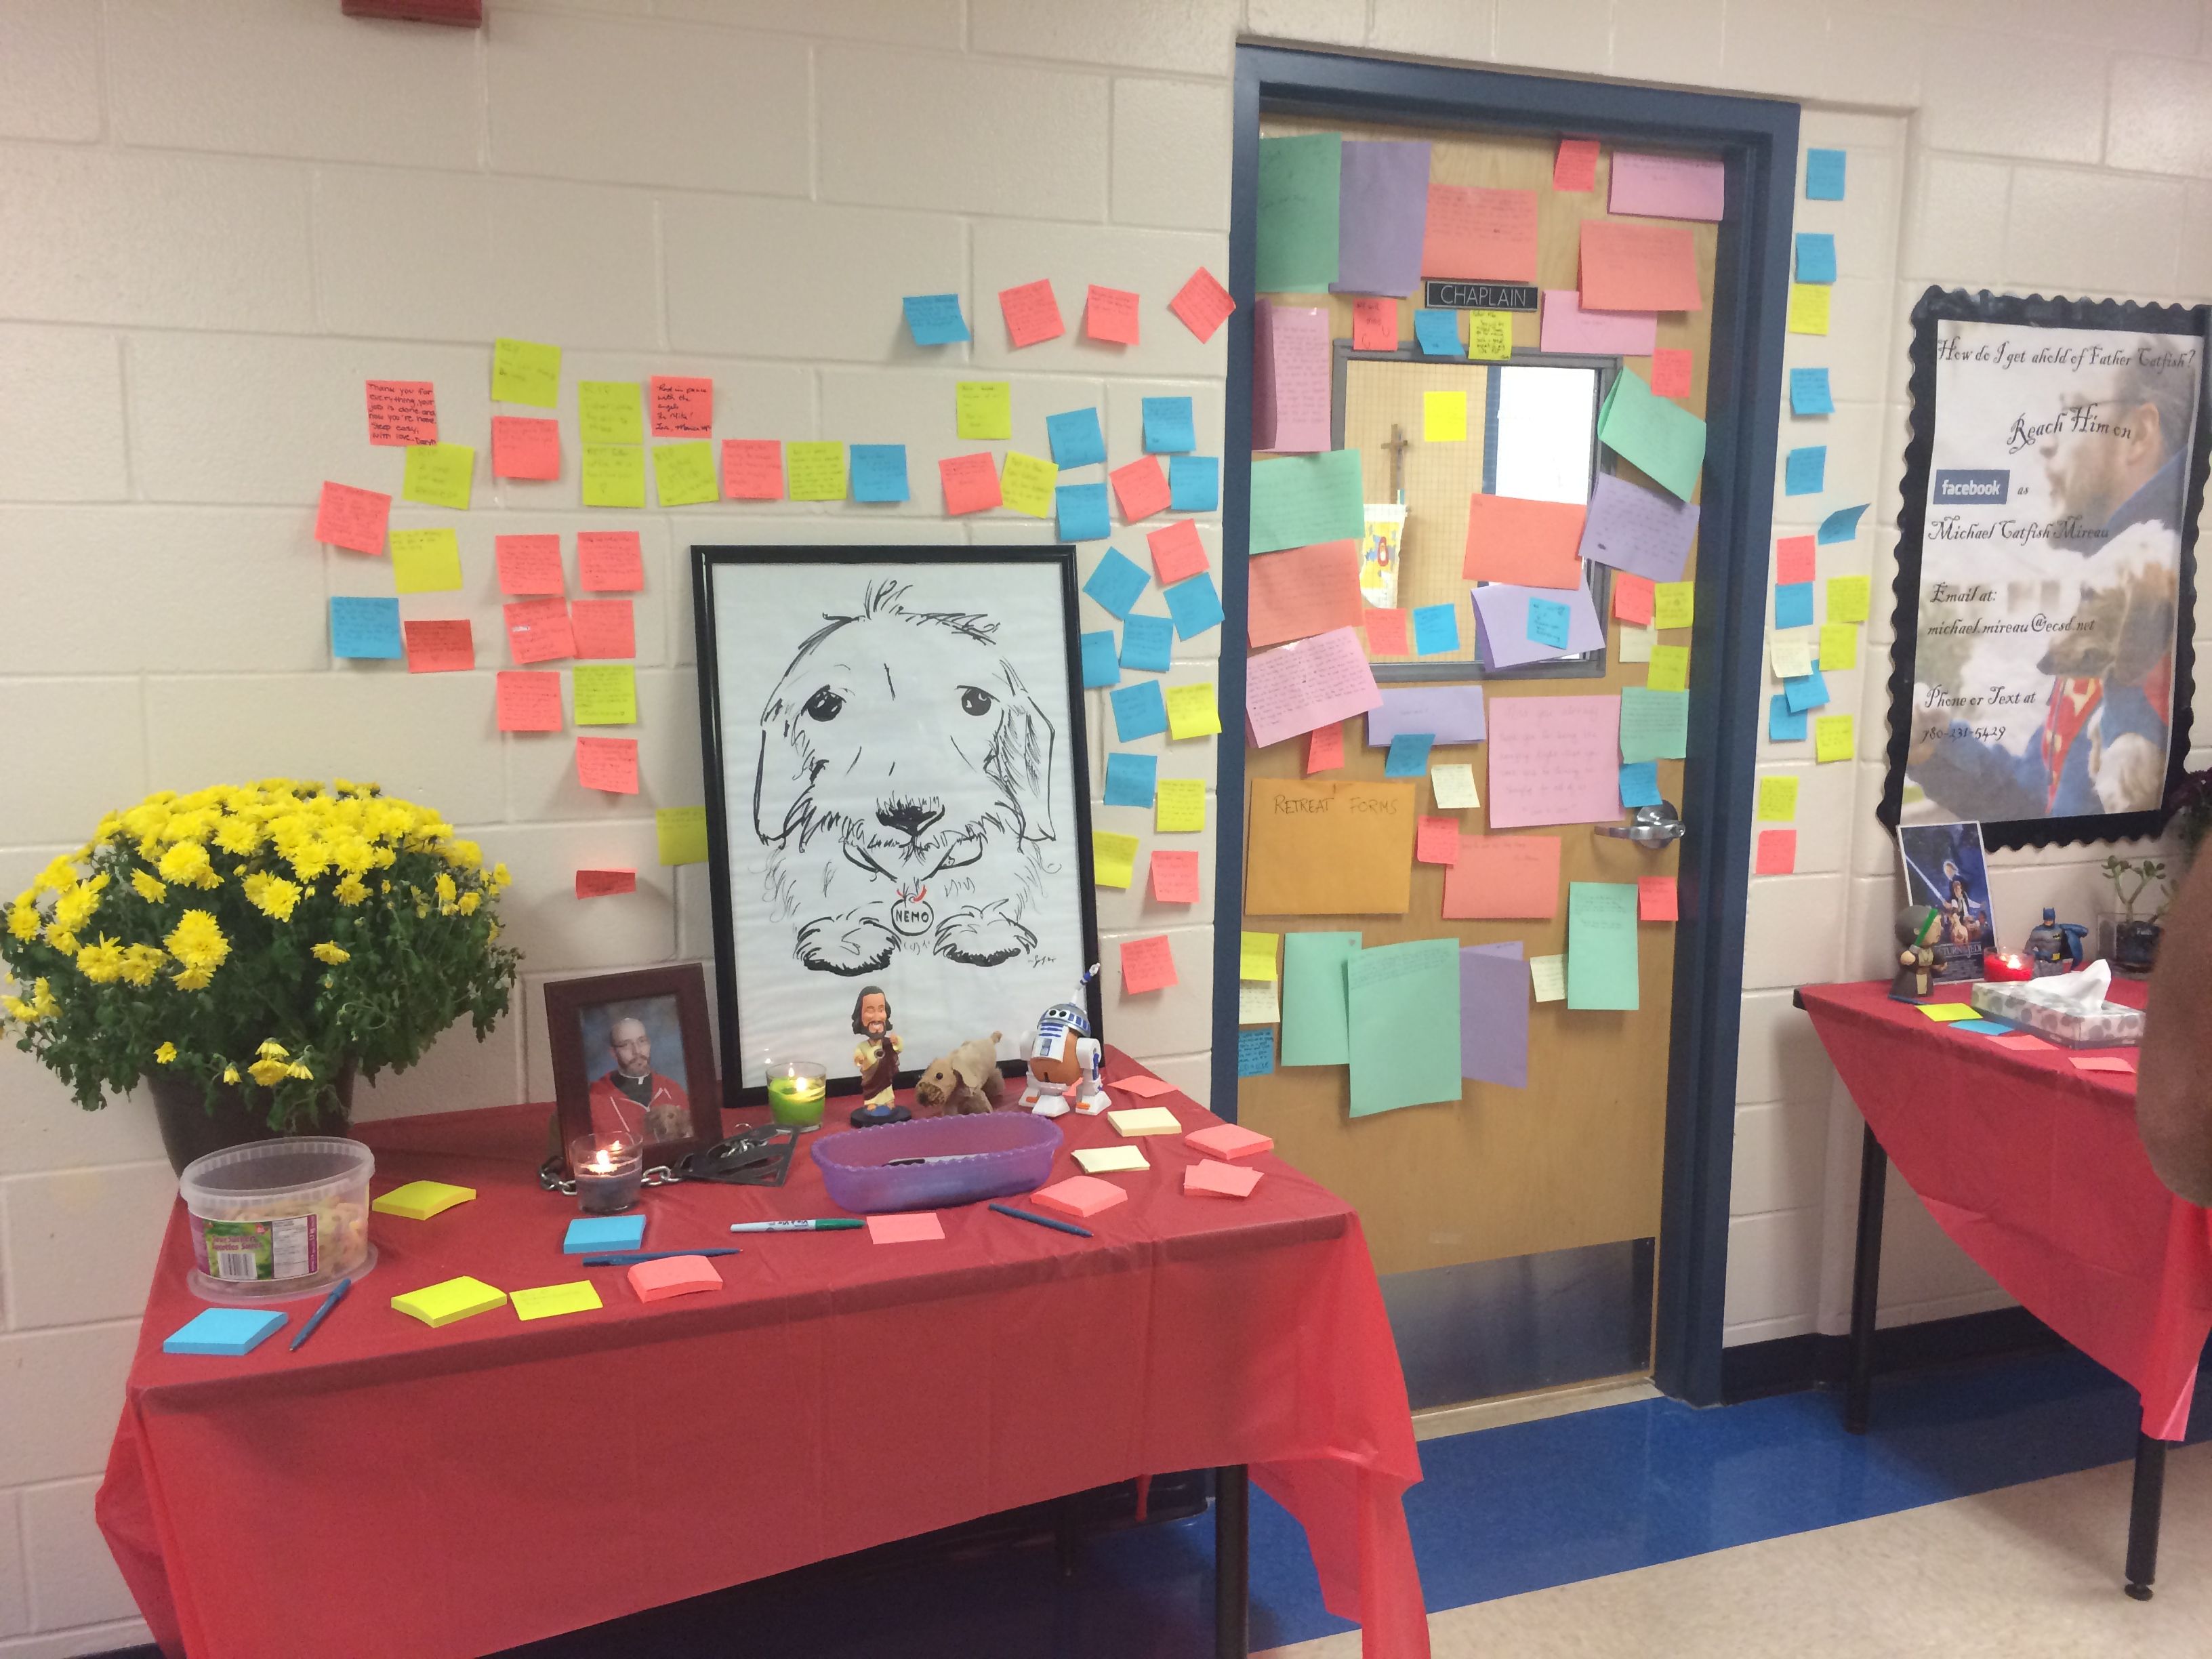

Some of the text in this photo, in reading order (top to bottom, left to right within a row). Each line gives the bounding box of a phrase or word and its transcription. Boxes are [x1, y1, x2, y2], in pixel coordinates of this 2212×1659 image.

[1440, 285, 1526, 307] CHAPLAIN
[1938, 336, 2196, 374] How do I get ahold of Father Catfish?
[368, 383, 394, 392] Thank
[400, 388, 415, 396] you
[2007, 403, 2131, 455] Reach Him on
[1942, 479, 2029, 495] facebook as
[1928, 515, 2109, 546] Michael Catfish Mireau
[1930, 581, 1996, 603] Email at:
[1925, 684, 2036, 708] Phone or Text at
[1919, 726, 2006, 744] 780-231-5429
[1274, 794, 1399, 815] RETREAT FORMS
[896, 909, 928, 922] NEMO
